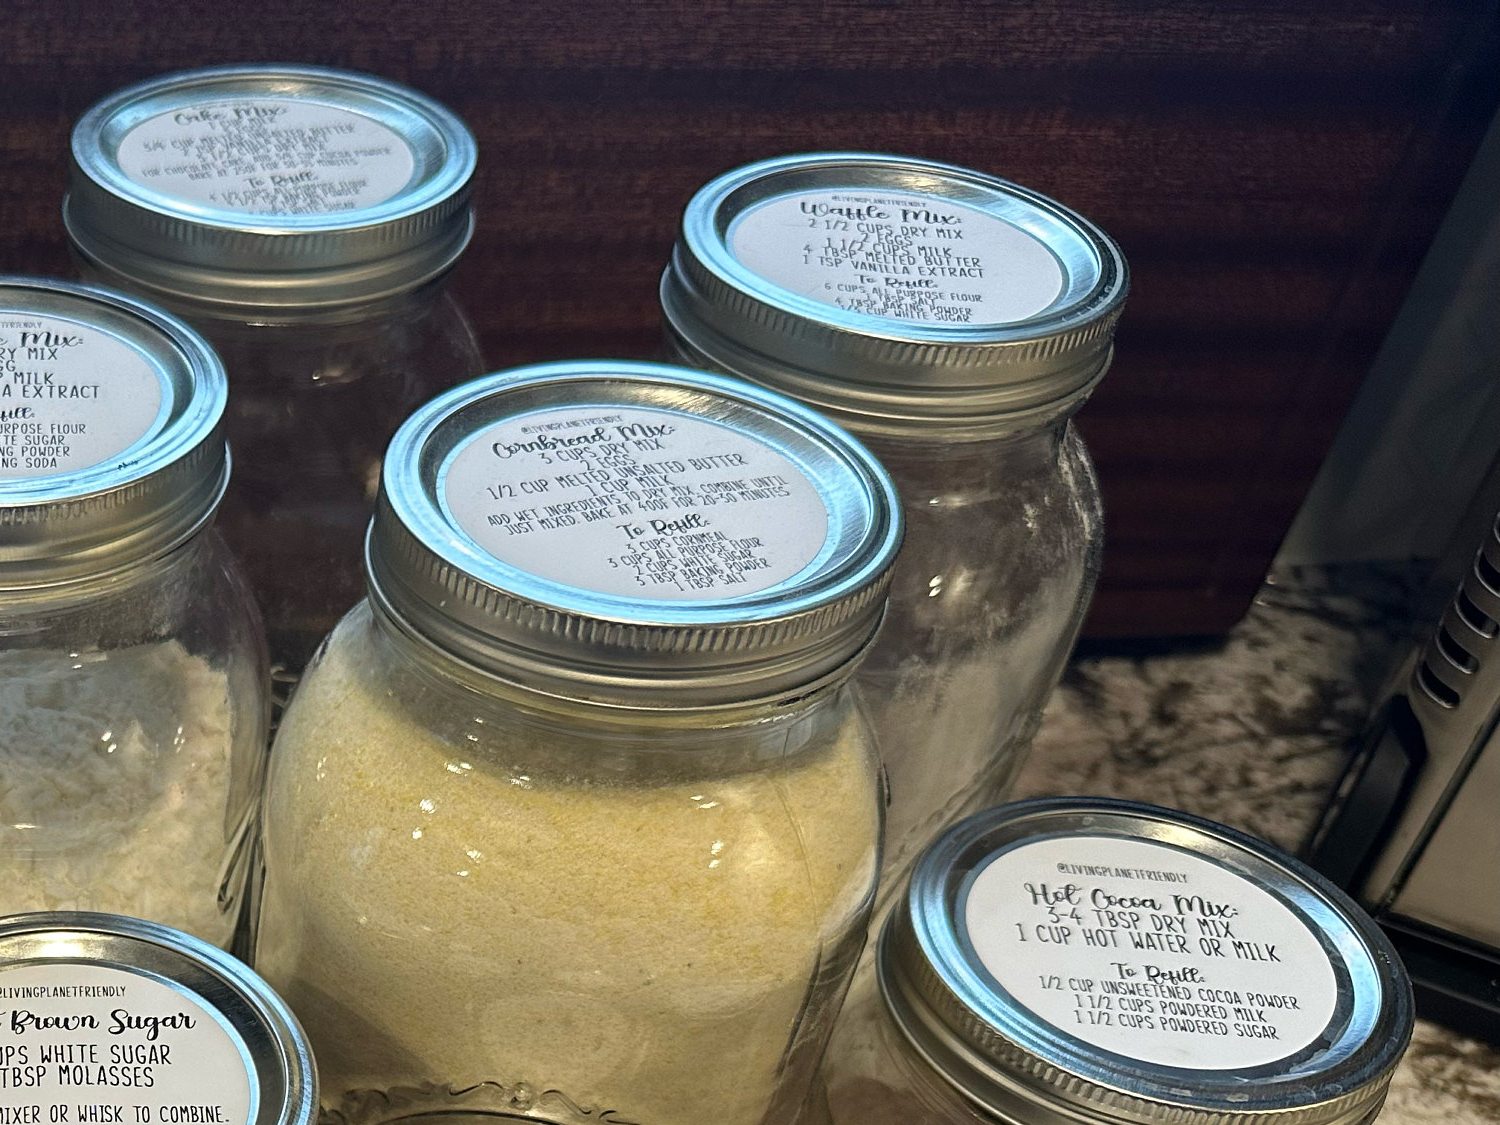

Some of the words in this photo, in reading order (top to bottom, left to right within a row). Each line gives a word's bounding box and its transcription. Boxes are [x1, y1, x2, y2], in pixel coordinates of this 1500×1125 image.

[800, 201, 890, 222] Waffle
[808, 218, 816, 228] 2
[825, 220, 849, 232] 1/2
[856, 222, 892, 236] CUPS
[900, 226, 928, 238] DRY
[935, 228, 963, 239] MIX
[863, 233, 870, 243] 2
[876, 234, 913, 247] EGGS
[20, 332, 83, 348] Mix:
[27, 347, 58, 360] MIX
[492, 429, 611, 458] Cornbread
[617, 423, 675, 441] Mix:
[539, 452, 552, 464] 3
[558, 447, 600, 462] CUPS
[603, 443, 632, 456] DRY
[633, 437, 665, 453] MIX
[580, 459, 593, 471] 2
[595, 454, 635, 469] EGGS
[1057, 863, 1188, 884] @LIVINGPLANETFRIENDLY
[1024, 883, 1083, 906] Hot
[1090, 888, 1161, 912] Cocoa
[1171, 894, 1238, 918] Mix:
[1048, 906, 1081, 926] 3-4
[1096, 910, 1140, 931] TBSP
[1150, 914, 1188, 935] DRY
[1198, 918, 1234, 939] MIX
[11, 1009, 99, 1035] Brown
[108, 1008, 196, 1041] Sugar
[40, 1045, 98, 1064] WHITE
[111, 1045, 171, 1064] SUGAR
[0, 1067, 47, 1087] TBSP
[59, 1067, 154, 1087] MOLASSES
